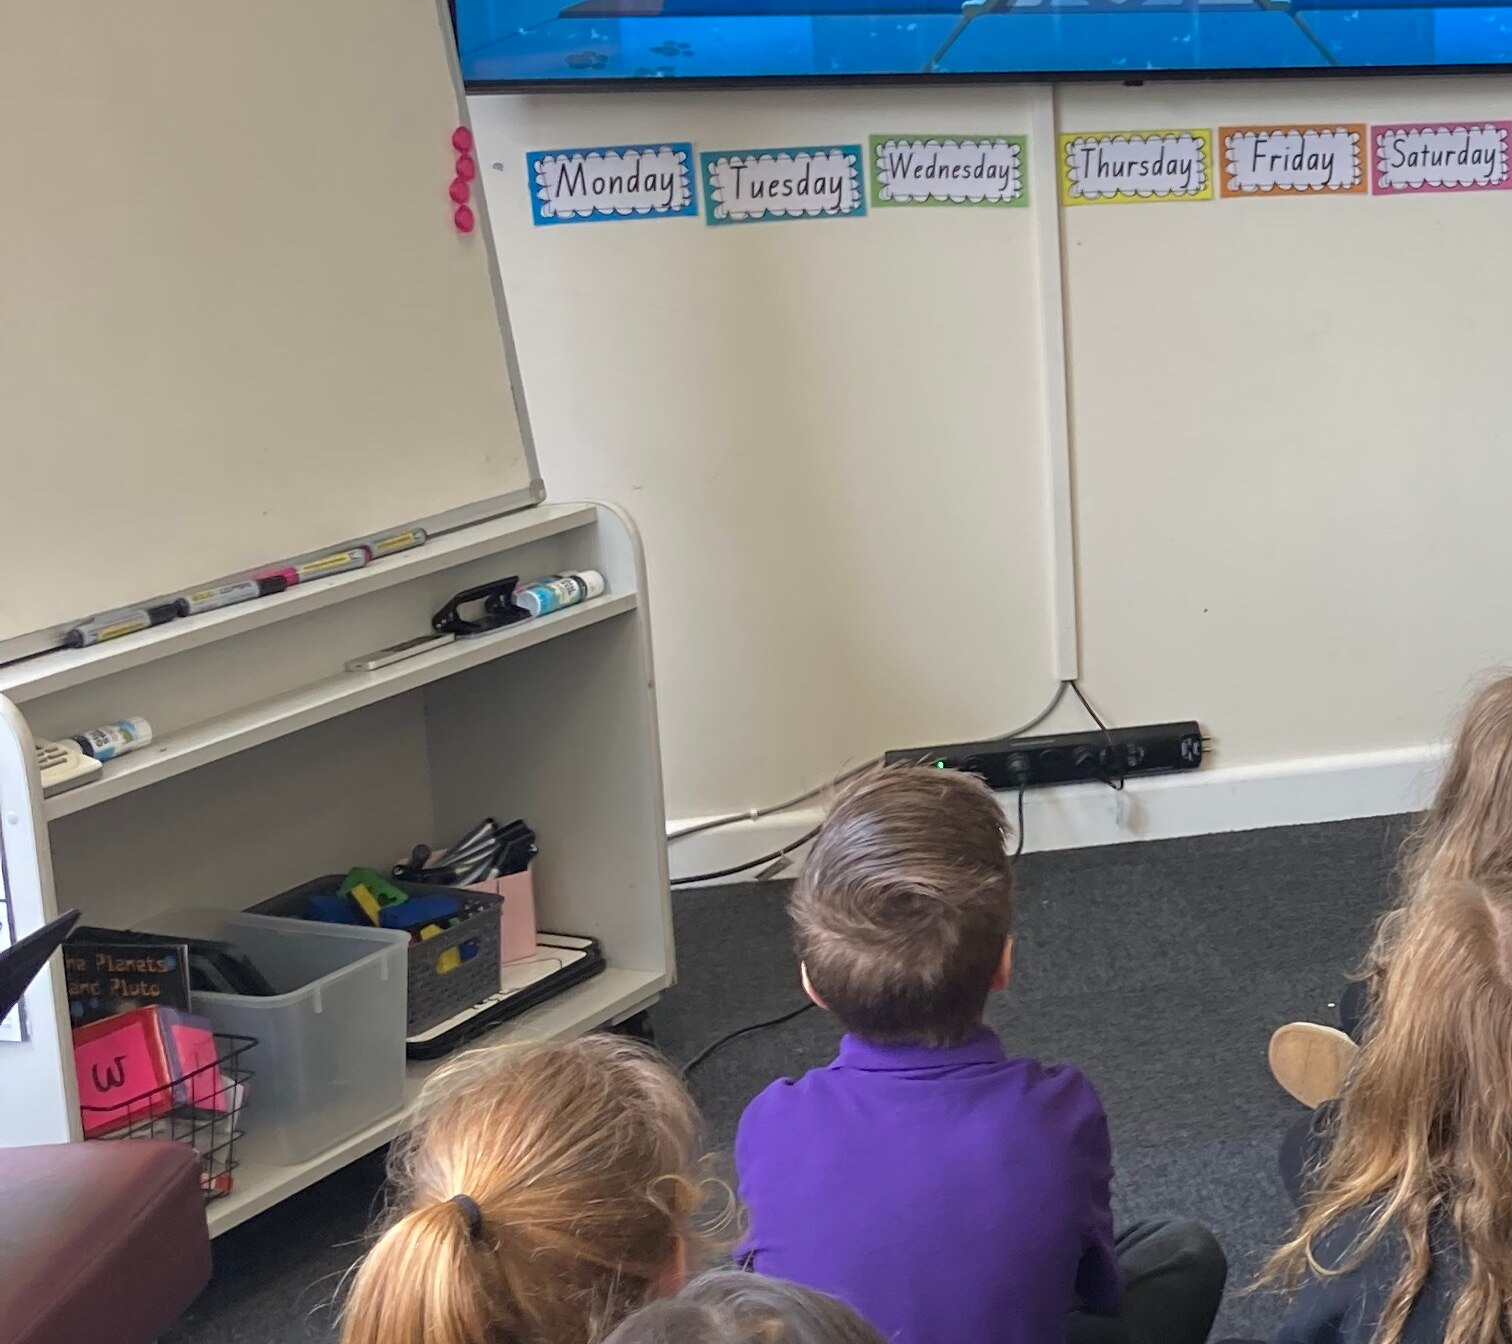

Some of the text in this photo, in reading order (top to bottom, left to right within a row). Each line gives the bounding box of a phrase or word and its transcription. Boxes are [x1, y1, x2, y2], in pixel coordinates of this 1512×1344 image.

[890, 153, 1011, 192] Wednesday
[1081, 145, 1193, 189] Thursday
[1252, 139, 1336, 186] Friday
[1391, 136, 1496, 178] Saturday
[555, 160, 675, 209] Monday
[730, 162, 844, 211] Tuesday
[96, 953, 167, 972] Planets
[110, 978, 160, 997] Pluto
